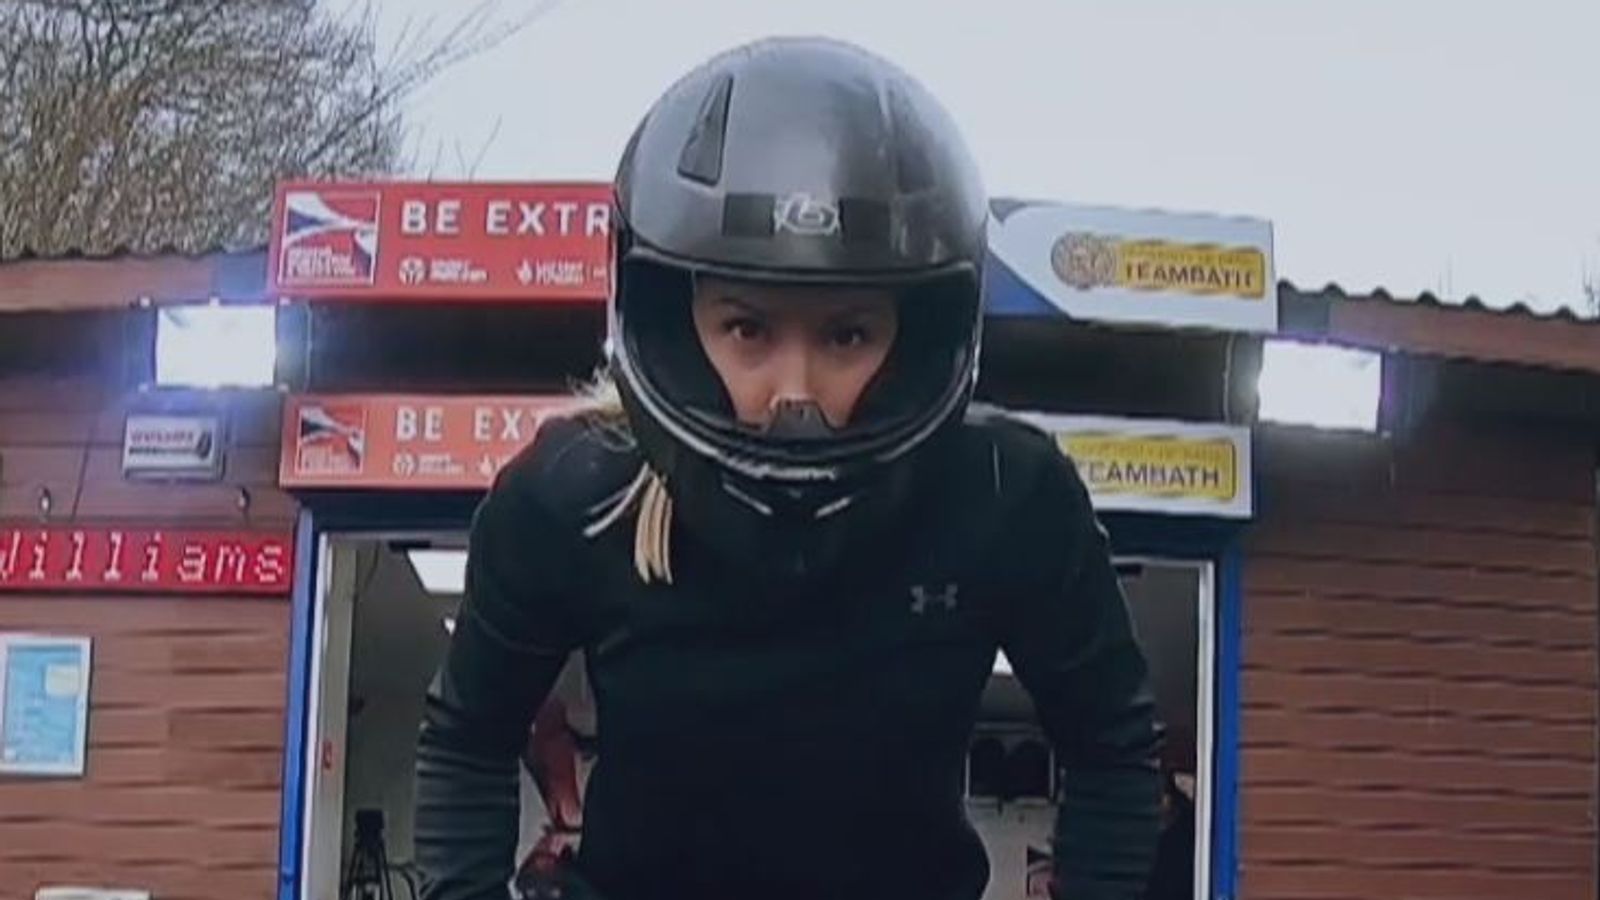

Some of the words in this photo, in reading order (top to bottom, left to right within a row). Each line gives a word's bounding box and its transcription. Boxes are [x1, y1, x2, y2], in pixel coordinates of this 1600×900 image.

[401, 200, 460, 236] BE
[486, 200, 610, 237] EXTR
[395, 405, 444, 441] BE
[1079, 459, 1220, 488] EAMBATH
